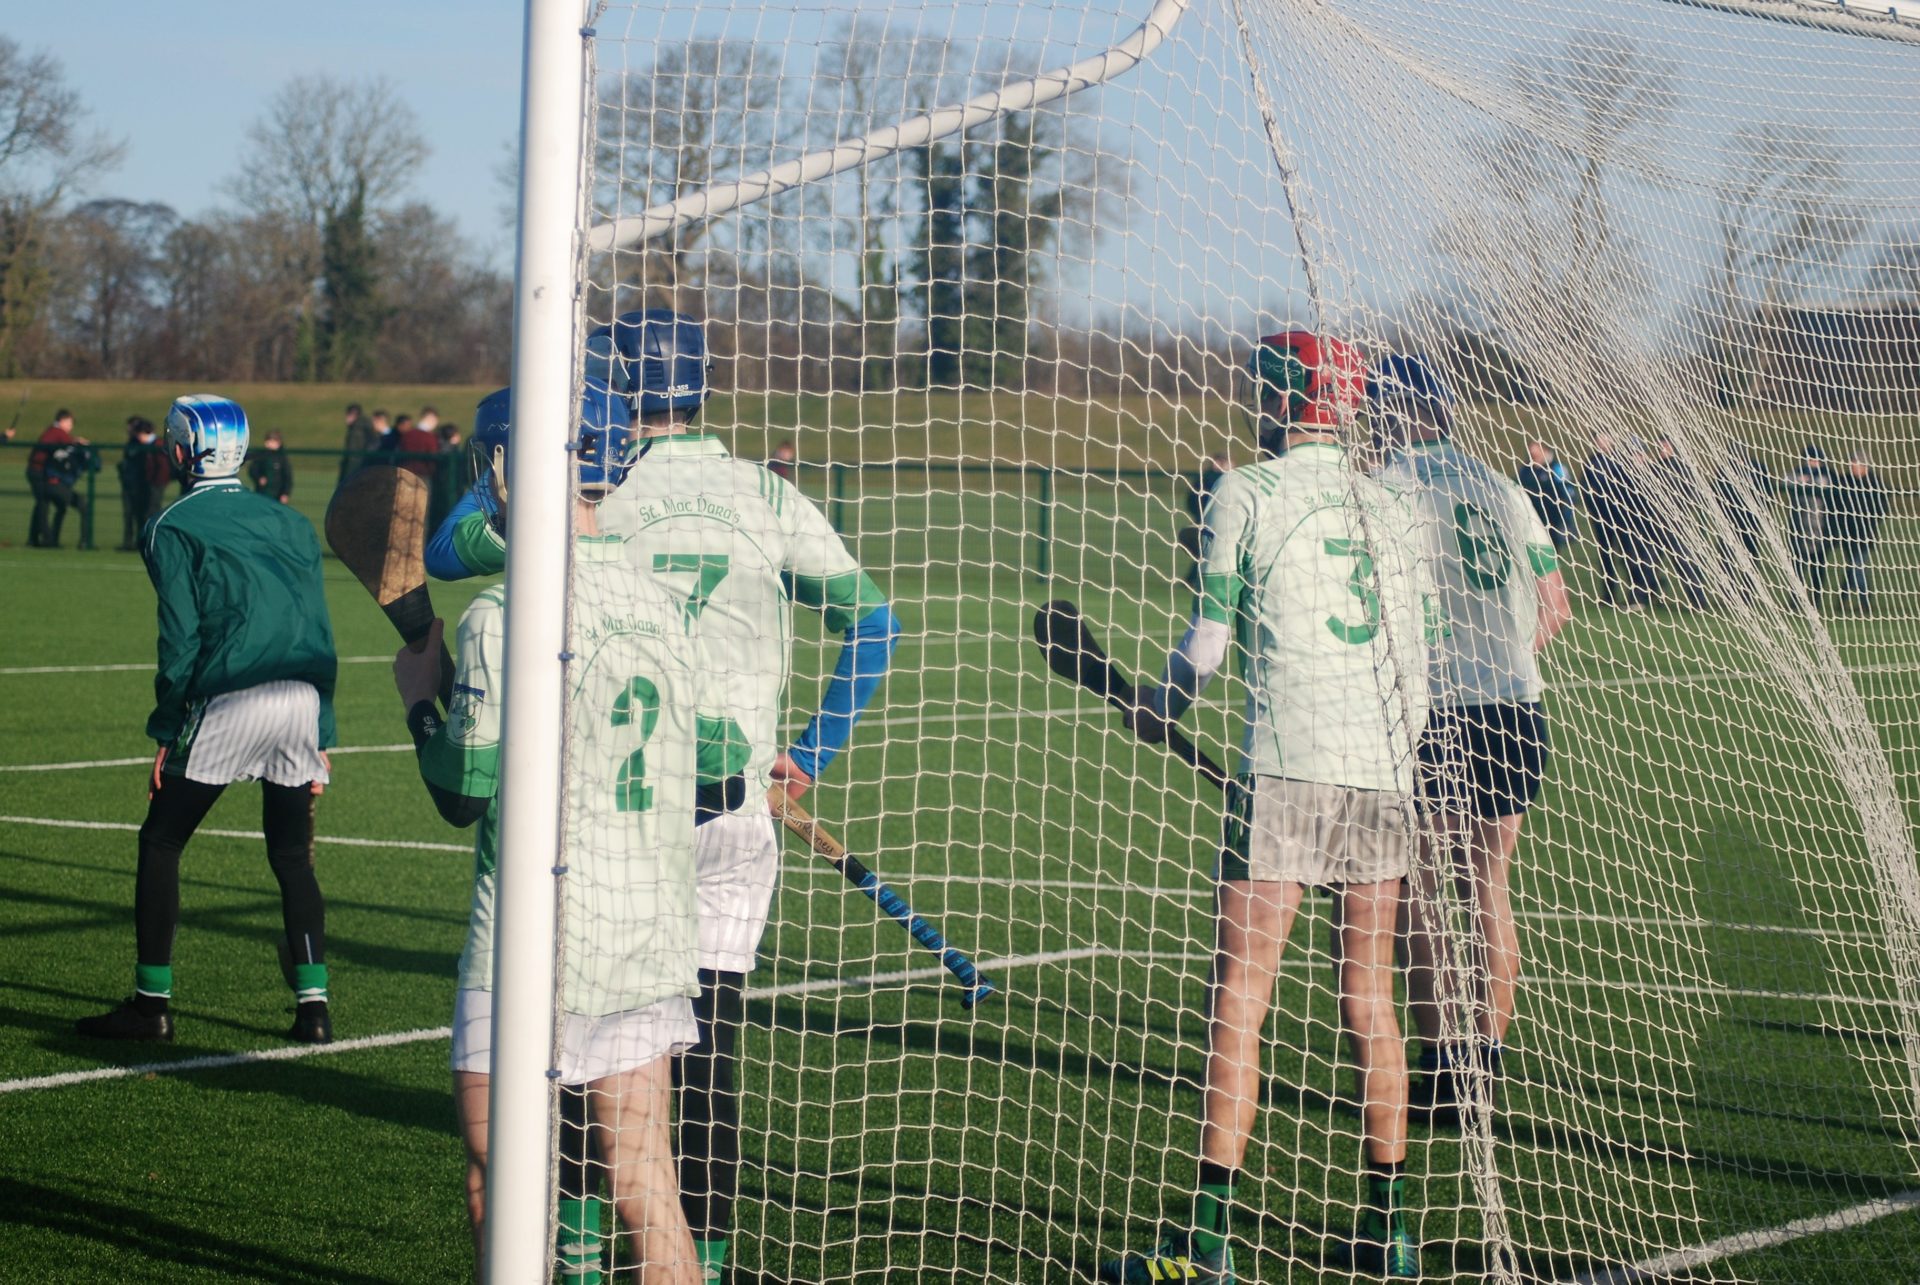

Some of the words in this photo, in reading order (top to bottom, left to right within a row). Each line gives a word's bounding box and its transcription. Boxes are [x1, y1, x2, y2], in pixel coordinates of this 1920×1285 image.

[640, 505, 661, 523] St.
[662, 499, 693, 514] Mac
[697, 498, 741, 524] Dara's
[1455, 502, 1511, 591] 6
[653, 554, 729, 621] 7
[1323, 537, 1380, 645] 3
[611, 675, 661, 812] 2
